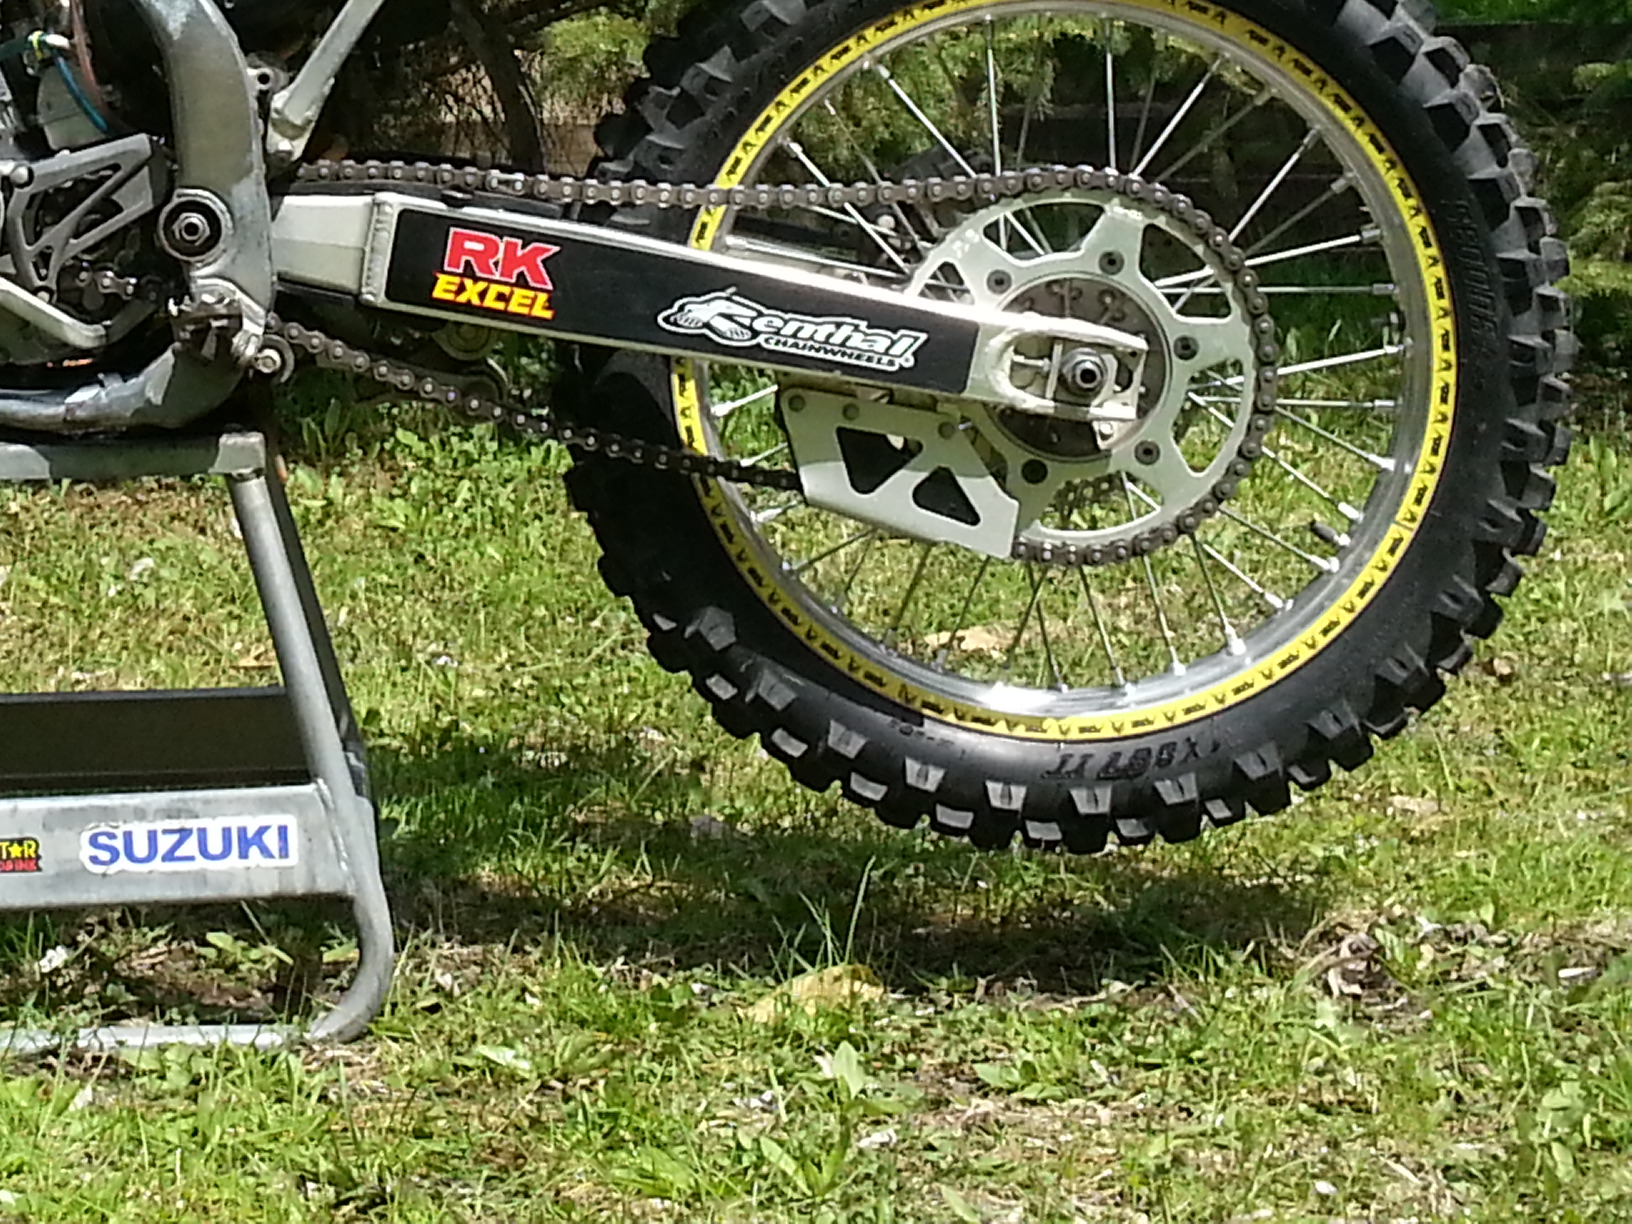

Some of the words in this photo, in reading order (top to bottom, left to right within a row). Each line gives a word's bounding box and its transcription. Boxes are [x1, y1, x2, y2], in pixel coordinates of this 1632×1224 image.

[444, 227, 561, 287] RK
[431, 272, 556, 320] EXCEL
[766, 335, 898, 368] CHAINWHEELS
[87, 824, 290, 866] SUZUKI
